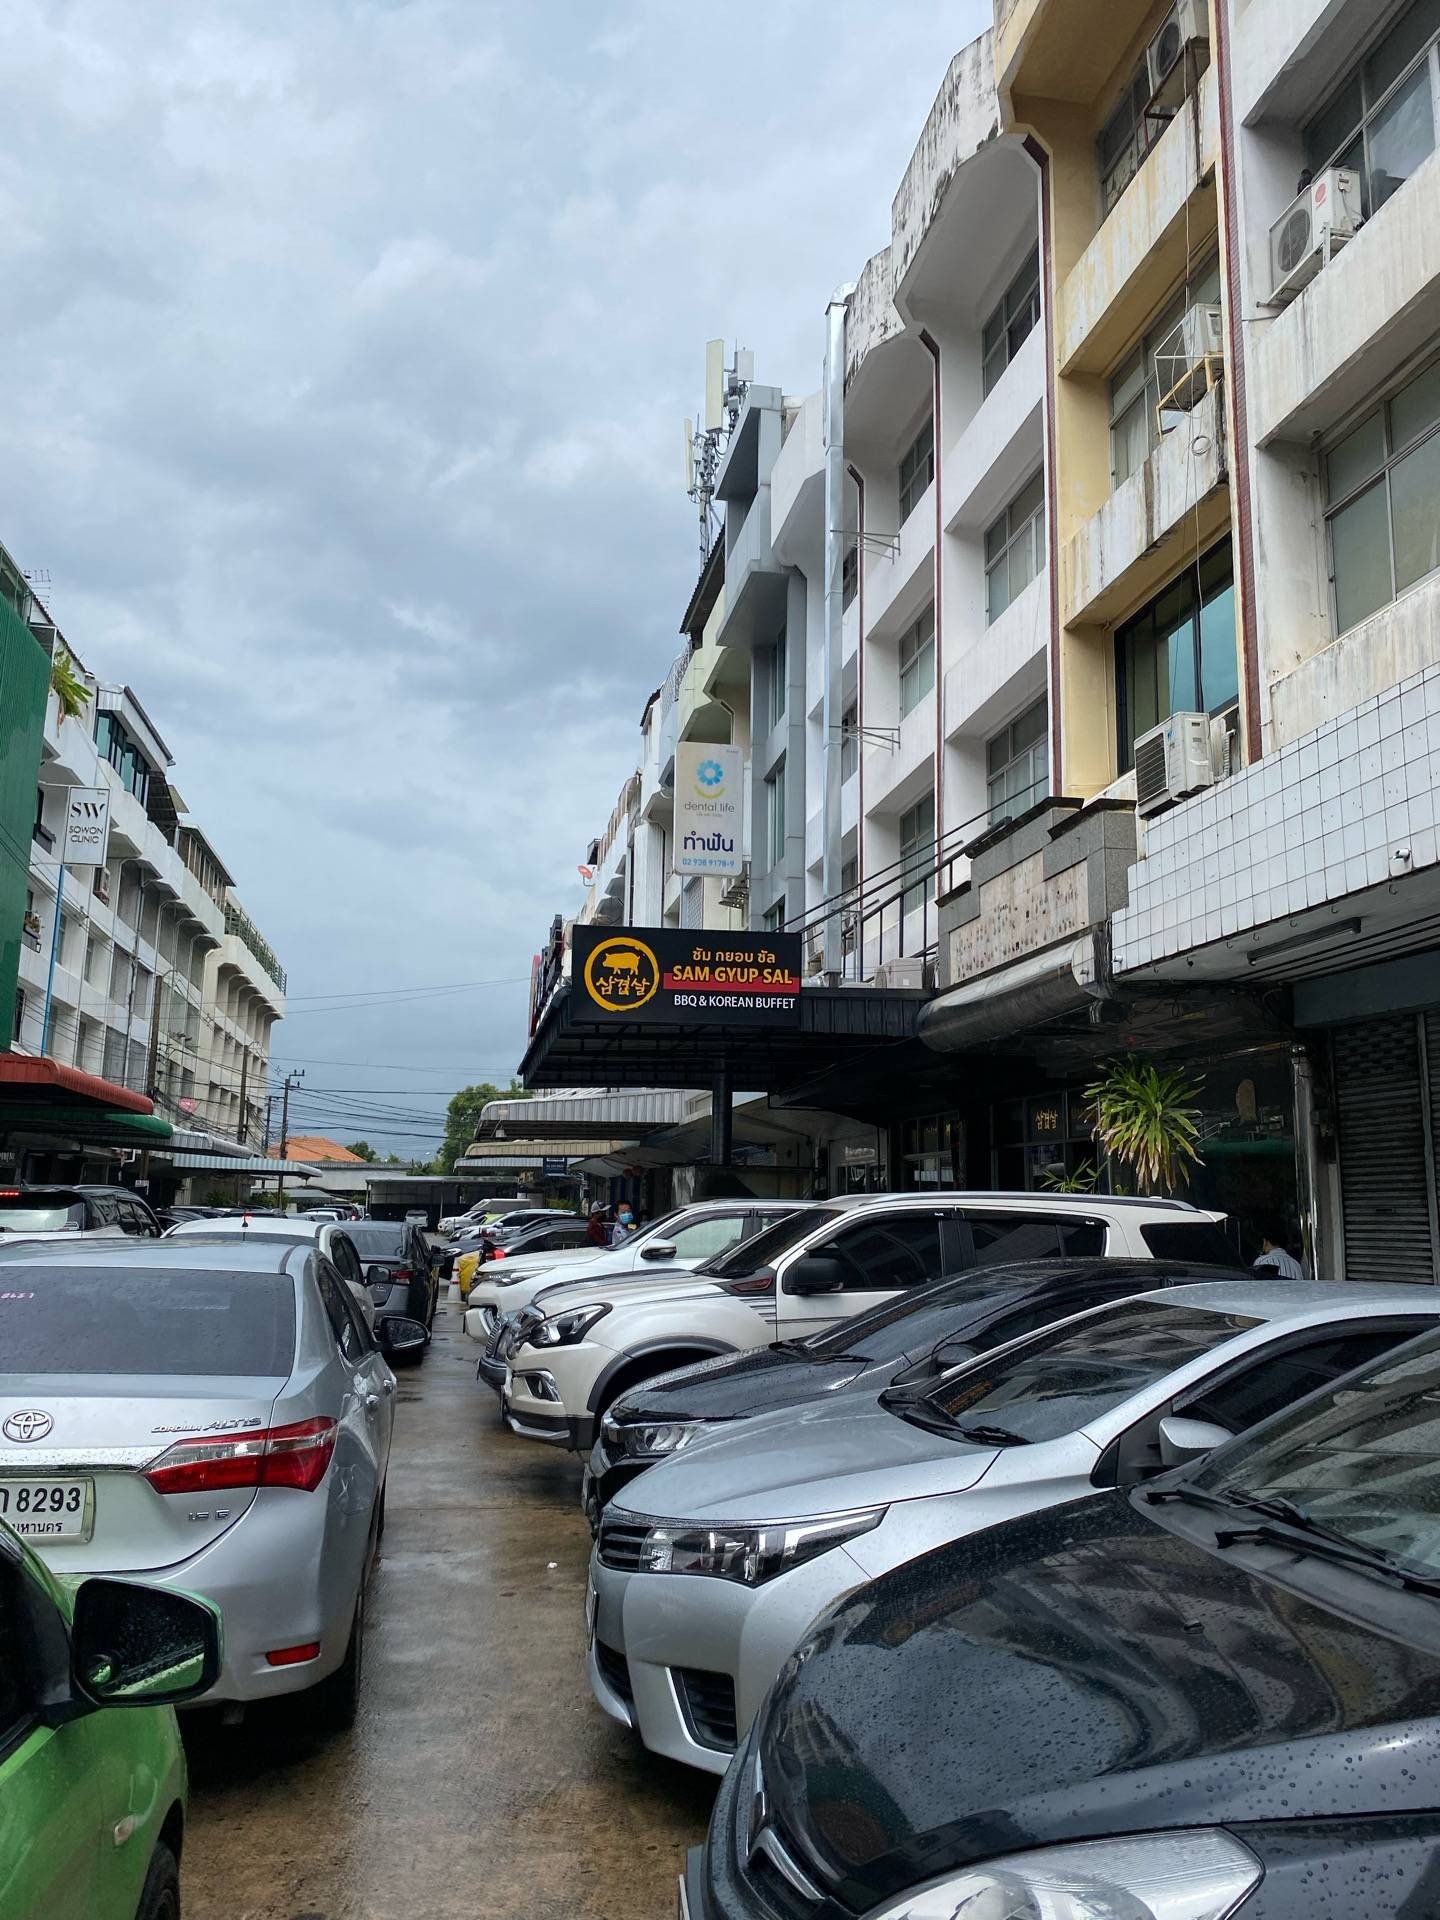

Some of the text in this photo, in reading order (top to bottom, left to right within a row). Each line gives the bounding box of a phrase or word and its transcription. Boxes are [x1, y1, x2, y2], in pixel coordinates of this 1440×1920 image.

[70, 801, 106, 819] SW
[684, 801, 735, 813] dental life
[69, 825, 104, 835] SOWON
[70, 834, 100, 844] CLINIC
[683, 830, 734, 852] ทำฟัน
[715, 951, 753, 963] กยอบ
[672, 965, 793, 985] SAM GYUP SAL
[596, 975, 650, 996] 삼겹살
[674, 994, 796, 1009] BBQ & KOREAN BUFFET
[203, 1417, 262, 1432] ALTIS
[16, 1487, 81, 1513] 8293
